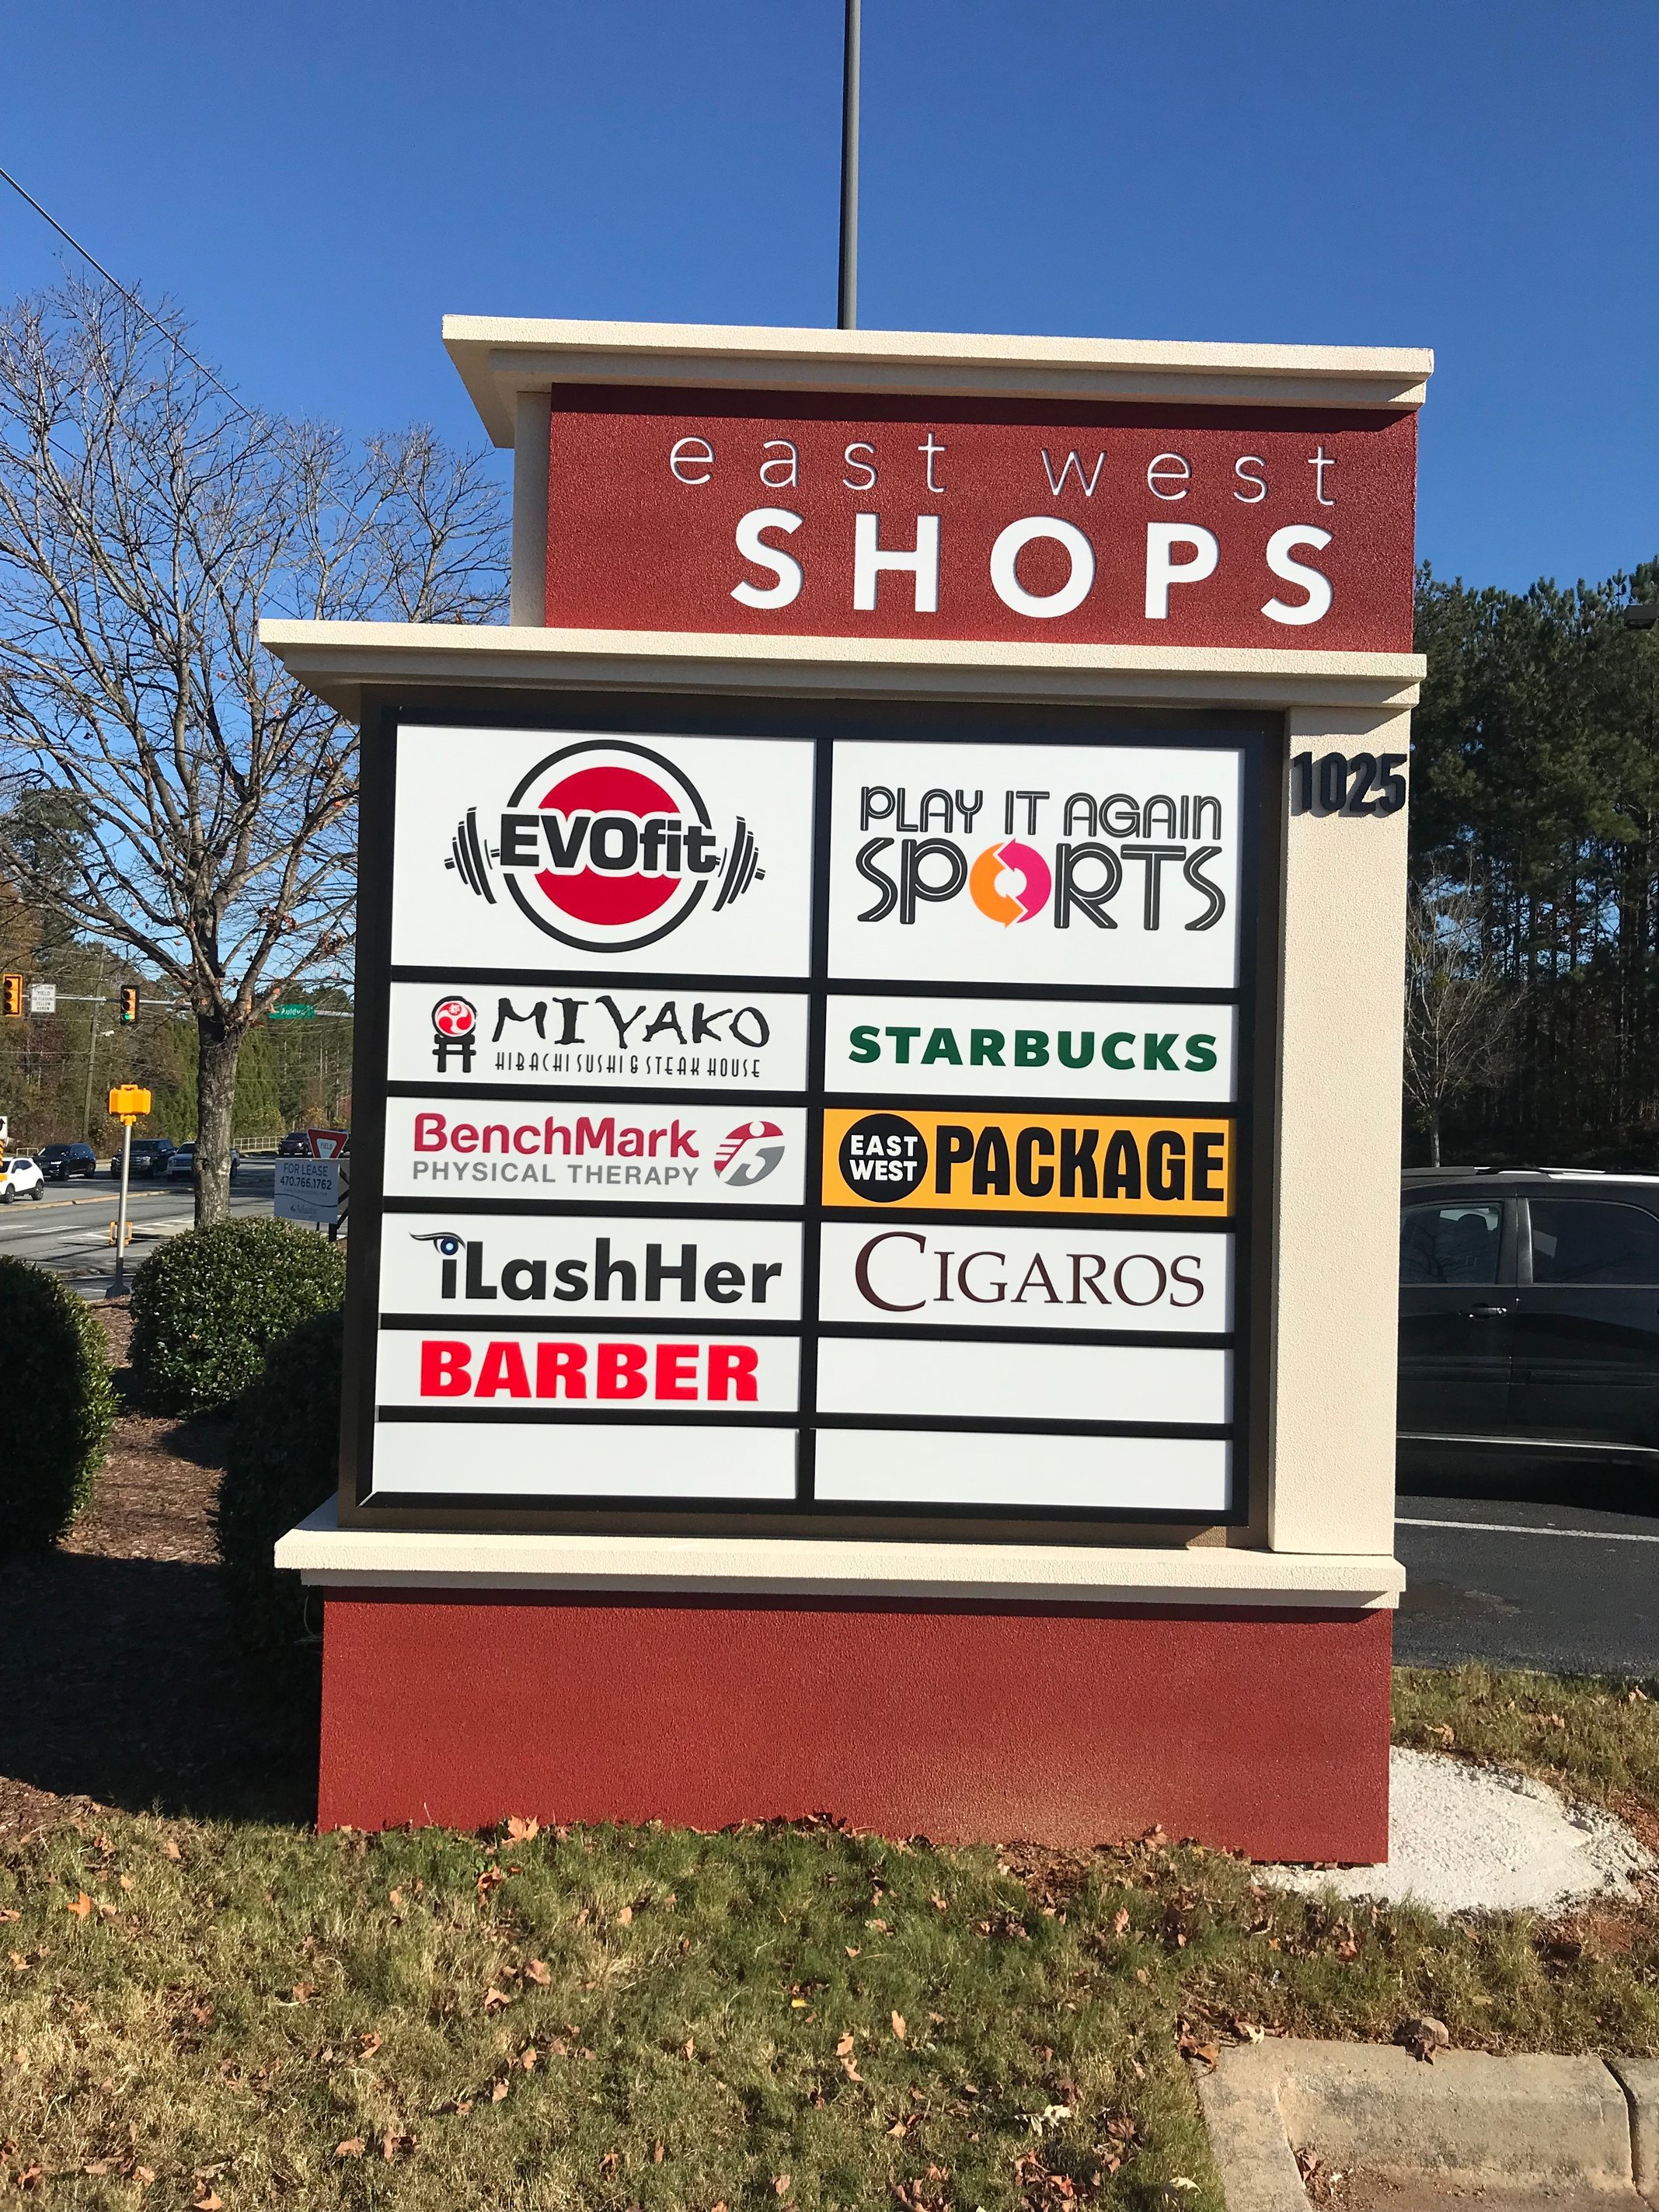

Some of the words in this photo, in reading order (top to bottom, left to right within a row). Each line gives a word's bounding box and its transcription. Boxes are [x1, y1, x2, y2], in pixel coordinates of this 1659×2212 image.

[670, 431, 948, 493] east
[1041, 445, 1337, 506] west
[730, 506, 1335, 626] SHOPS
[1293, 751, 1408, 813] 1025
[860, 786, 983, 834] PLAY
[1004, 789, 1050, 835] IT
[1062, 791, 1222, 840] AGAIN
[500, 813, 717, 873] EVOfit
[855, 836, 1226, 931] SPORTS
[492, 995, 770, 1049] MIYAKO
[848, 1025, 1218, 1072] STARBUCKS
[495, 1051, 570, 1072] HIBACHI
[577, 1054, 623, 1074] SUSHI
[646, 1055, 700, 1076] STEAK
[706, 1057, 761, 1078] HOUSE
[414, 1112, 700, 1158] BenchMark
[850, 1134, 918, 1158] EAST
[280, 1176, 333, 1190] 470.766.1762
[284, 1162, 300, 1175] FOR
[301, 1164, 328, 1177] LEASE
[413, 1161, 556, 1183] PHYSICAL
[567, 1164, 699, 1186] THERAPY
[849, 1158, 918, 1182] WEST
[935, 1124, 1225, 1202] PACKAGE
[440, 1236, 782, 1304] iLashHer
[420, 1340, 759, 1402] BARBER
